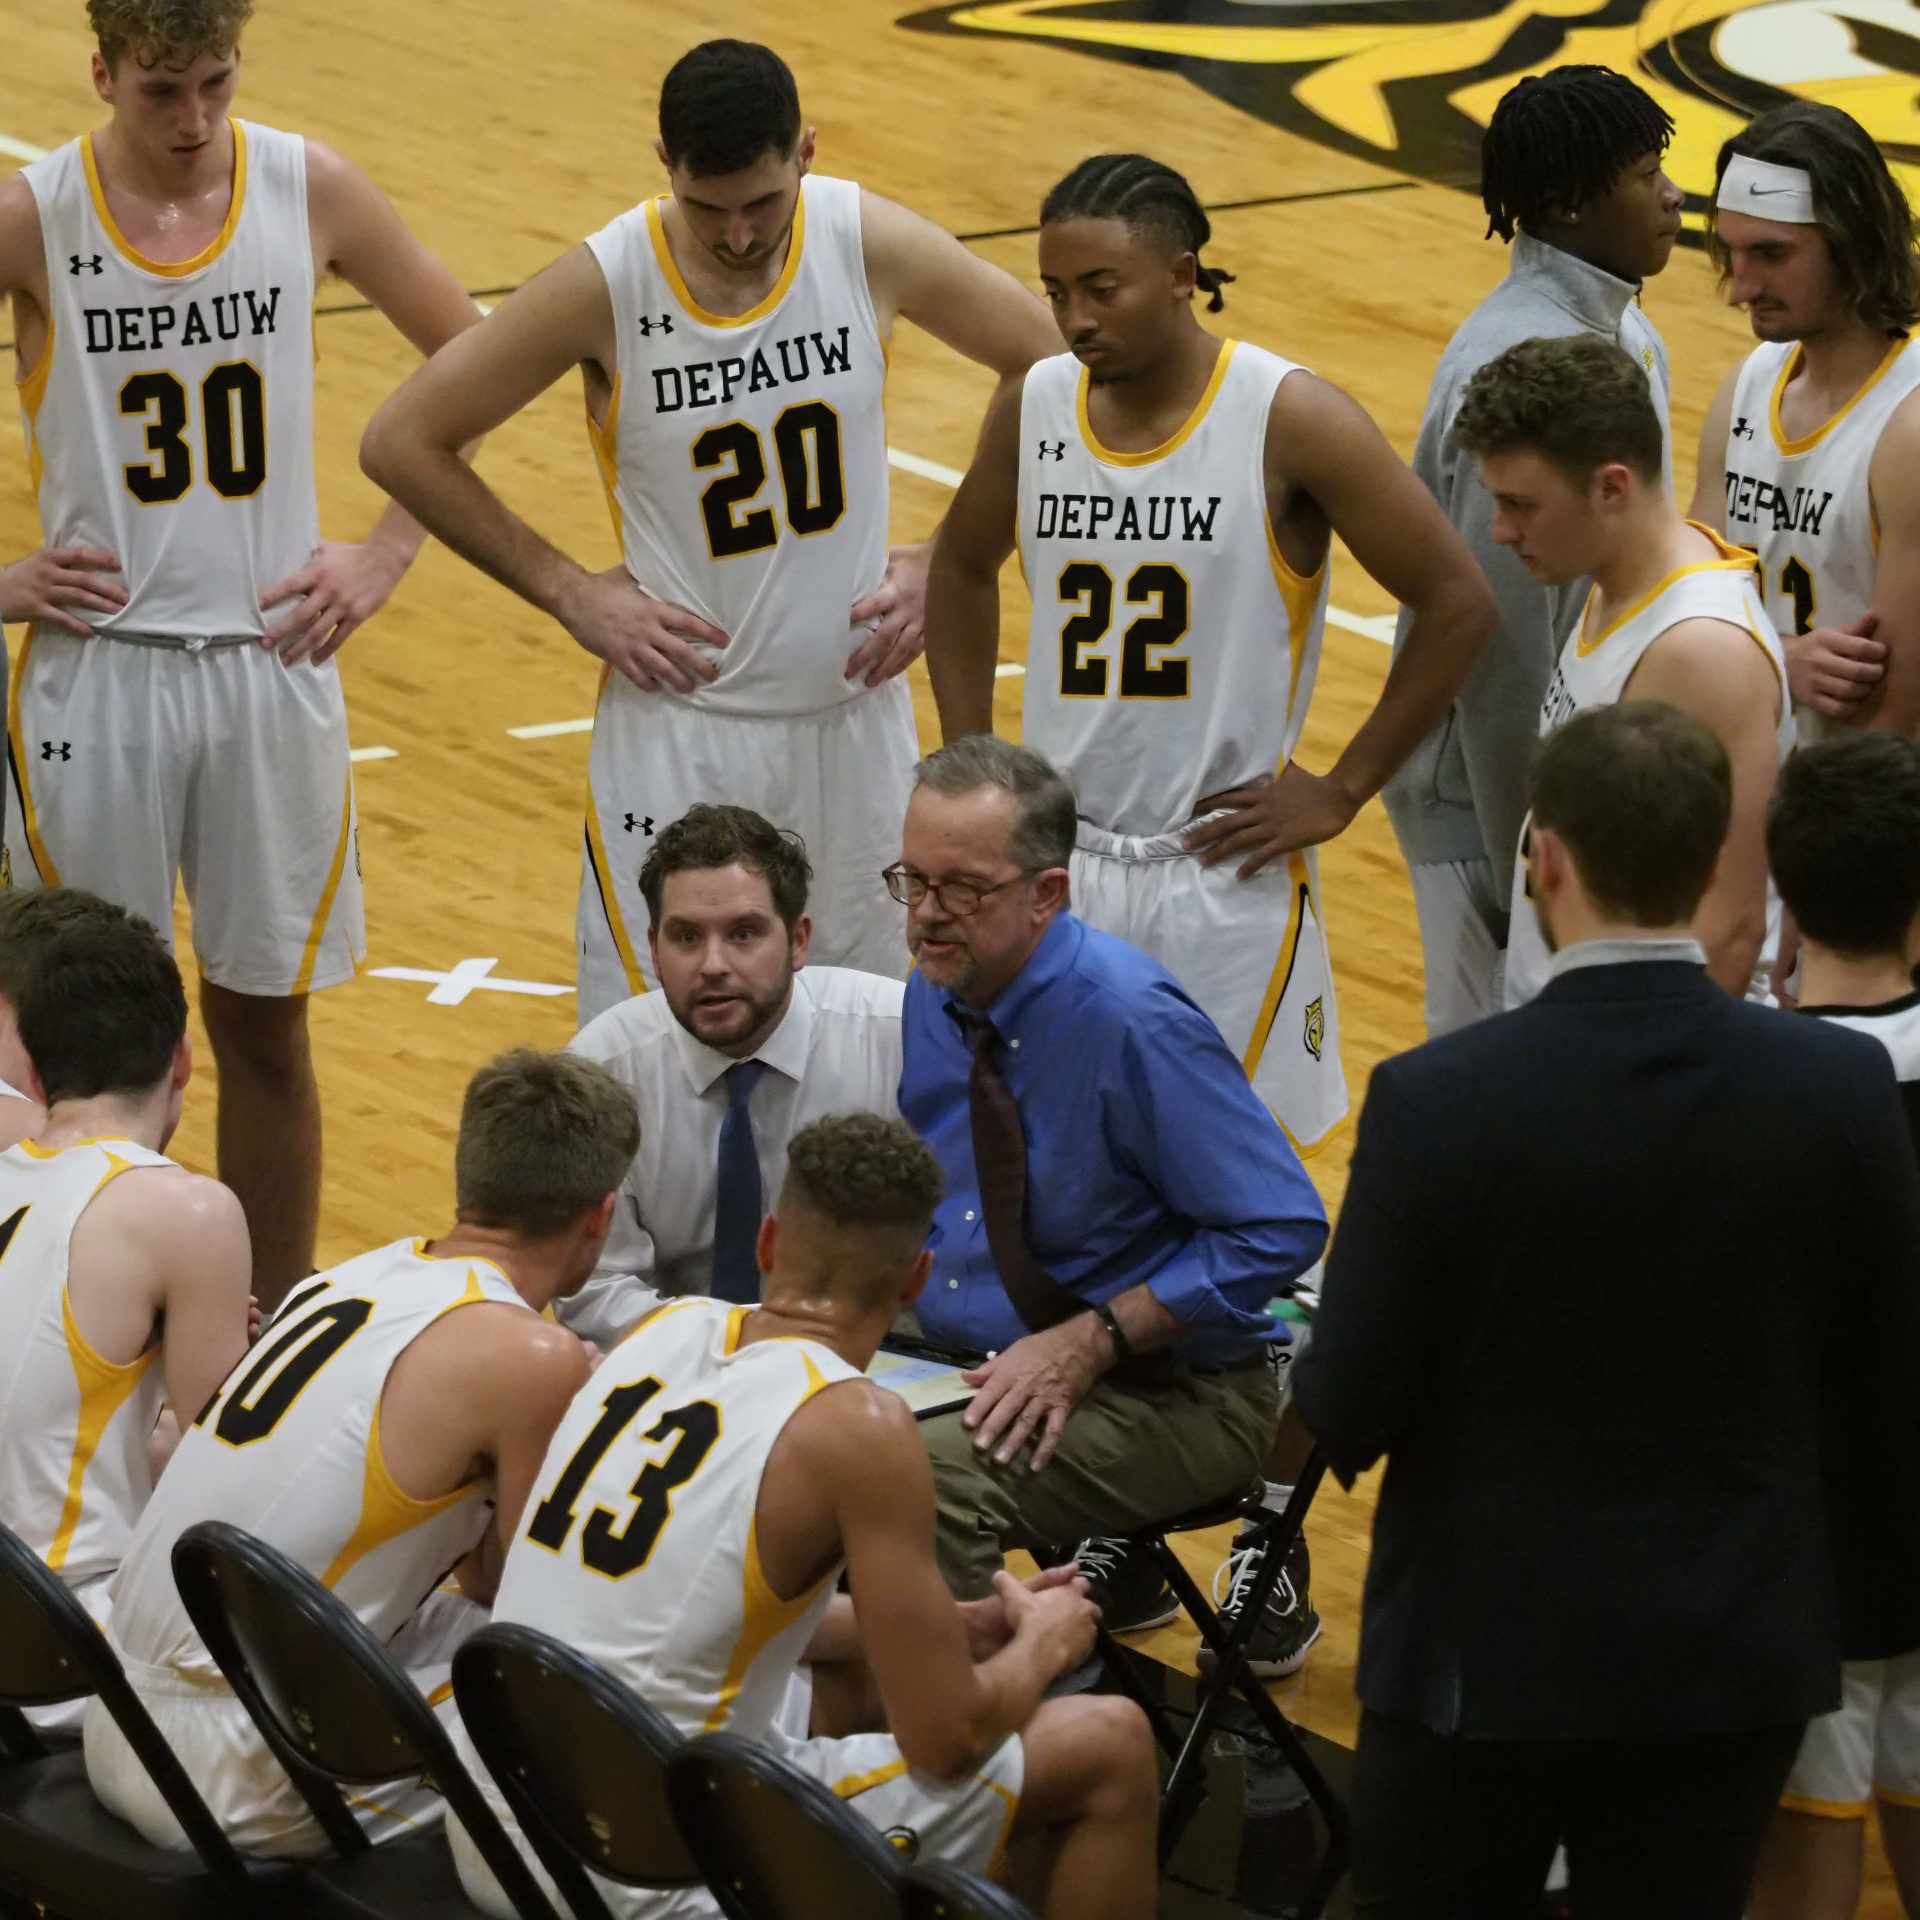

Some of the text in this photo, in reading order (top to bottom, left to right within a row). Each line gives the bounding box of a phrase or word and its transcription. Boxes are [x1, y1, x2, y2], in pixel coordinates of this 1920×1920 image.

[85, 287, 282, 354] DEPAUW
[652, 327, 853, 413] DEPAUW
[118, 359, 267, 504] 30
[690, 398, 847, 560] 20
[1036, 494, 1221, 541] DEPAUW
[1057, 560, 1191, 700] 22
[526, 1375, 722, 1580] 13
